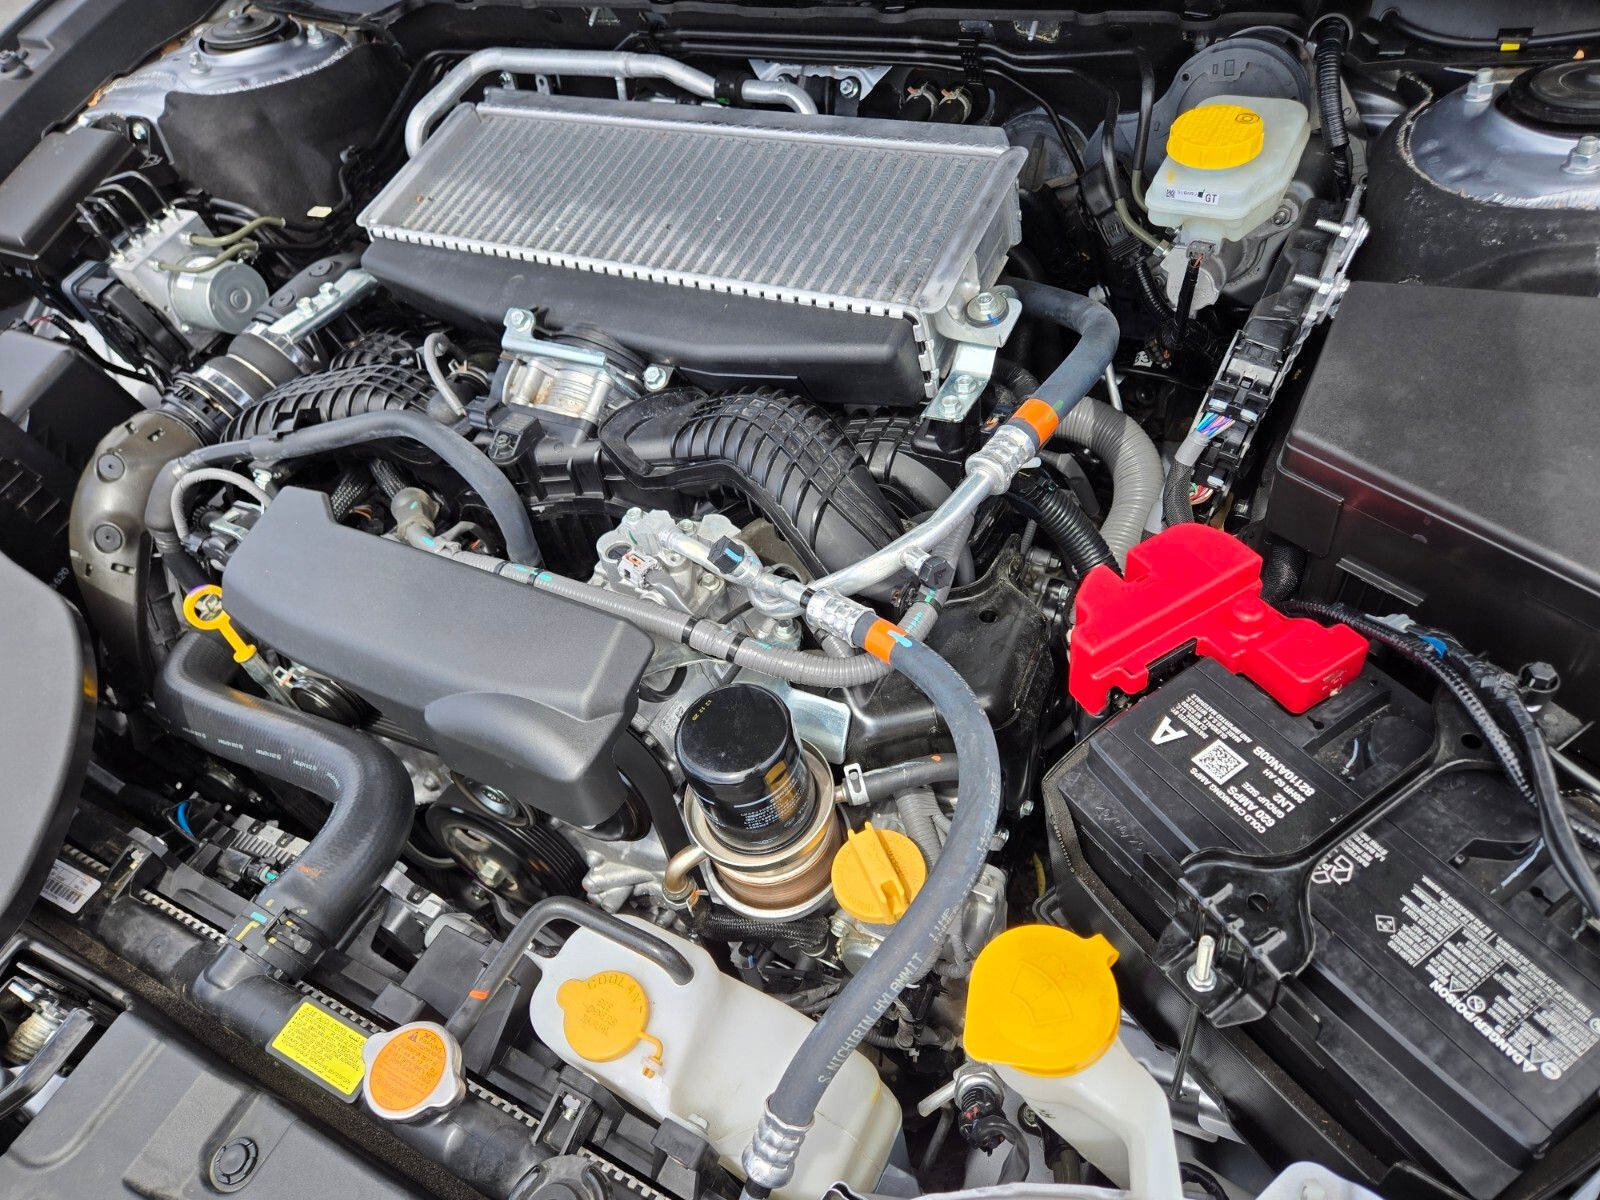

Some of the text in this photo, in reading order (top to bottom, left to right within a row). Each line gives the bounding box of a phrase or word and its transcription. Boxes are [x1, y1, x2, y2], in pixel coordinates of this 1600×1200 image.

[1205, 193, 1218, 203] GT
[1148, 714, 1188, 746] A
[1225, 728, 1242, 743] MADE
[1251, 744, 1316, 797] 82110AN00B
[1262, 767, 1306, 804] 20HR 62 AH
[1189, 766, 1267, 834] COLD CRANKING AMPS
[1225, 784, 1276, 827] 620 AMPS
[1241, 780, 1286, 818] GROUP SIZE
[1271, 791, 1296, 812] LN2
[1427, 977, 1527, 1065] DANGER/POISON
